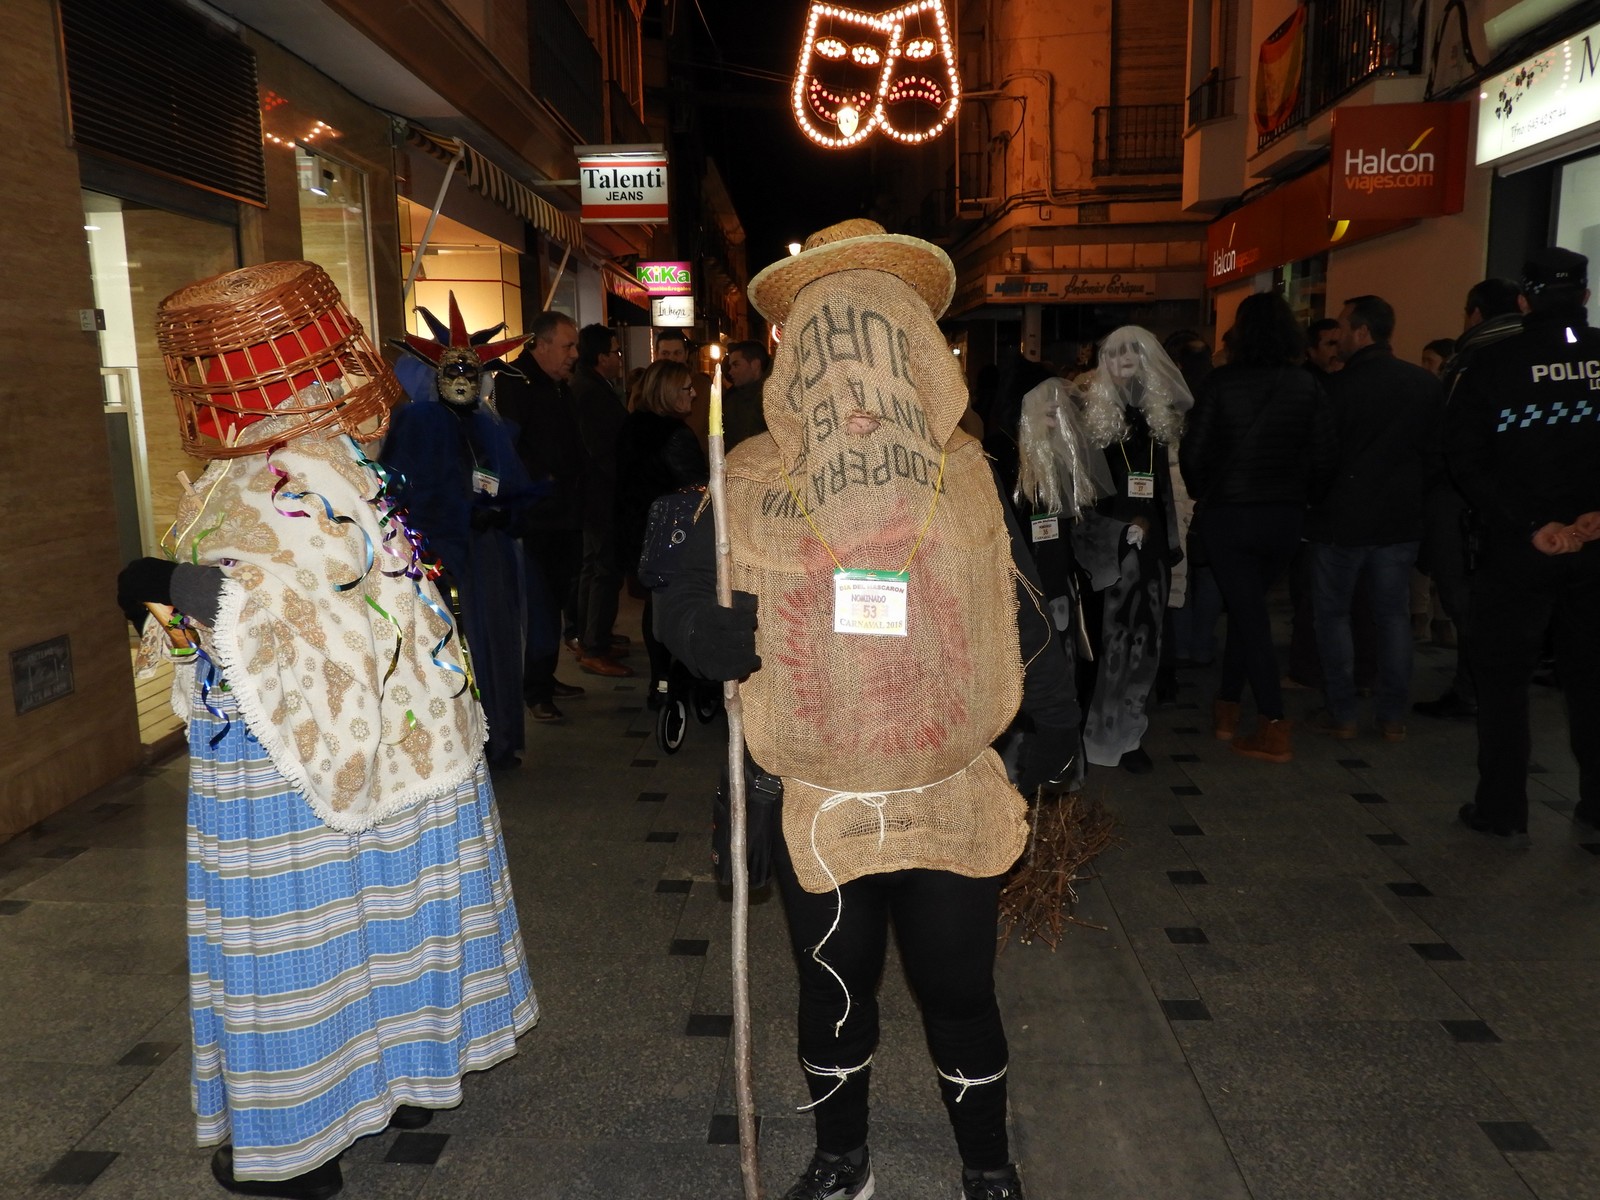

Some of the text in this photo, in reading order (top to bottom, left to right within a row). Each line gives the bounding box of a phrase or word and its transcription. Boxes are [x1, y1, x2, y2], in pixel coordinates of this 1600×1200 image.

[583, 167, 662, 189] Talenti
[1345, 173, 1434, 195] viajes.com
[606, 191, 644, 201] JEANS
[863, 605, 877, 619] 53
[839, 618, 885, 630] CARNAVAL
